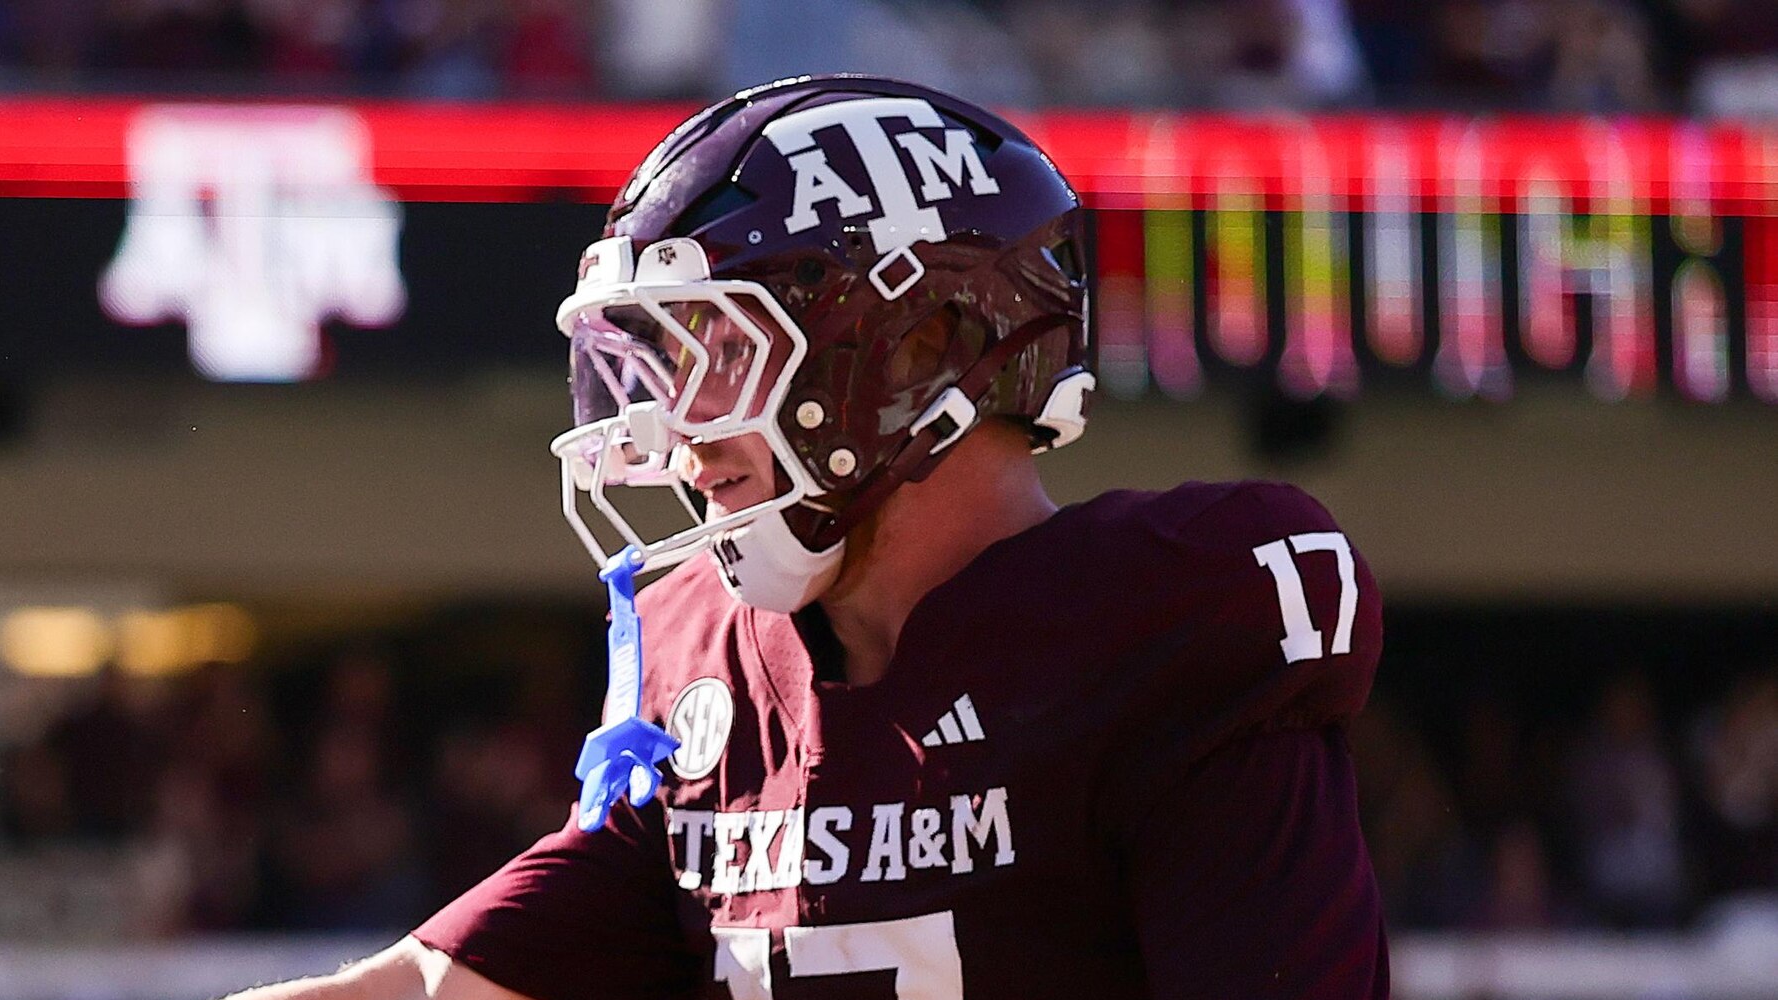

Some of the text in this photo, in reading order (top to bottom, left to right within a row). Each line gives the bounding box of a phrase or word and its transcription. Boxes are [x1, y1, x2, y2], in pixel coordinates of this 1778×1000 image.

[1252, 531, 1358, 664] 17
[673, 683, 728, 774] SEC
[668, 787, 1015, 893] TEXAS A&M
